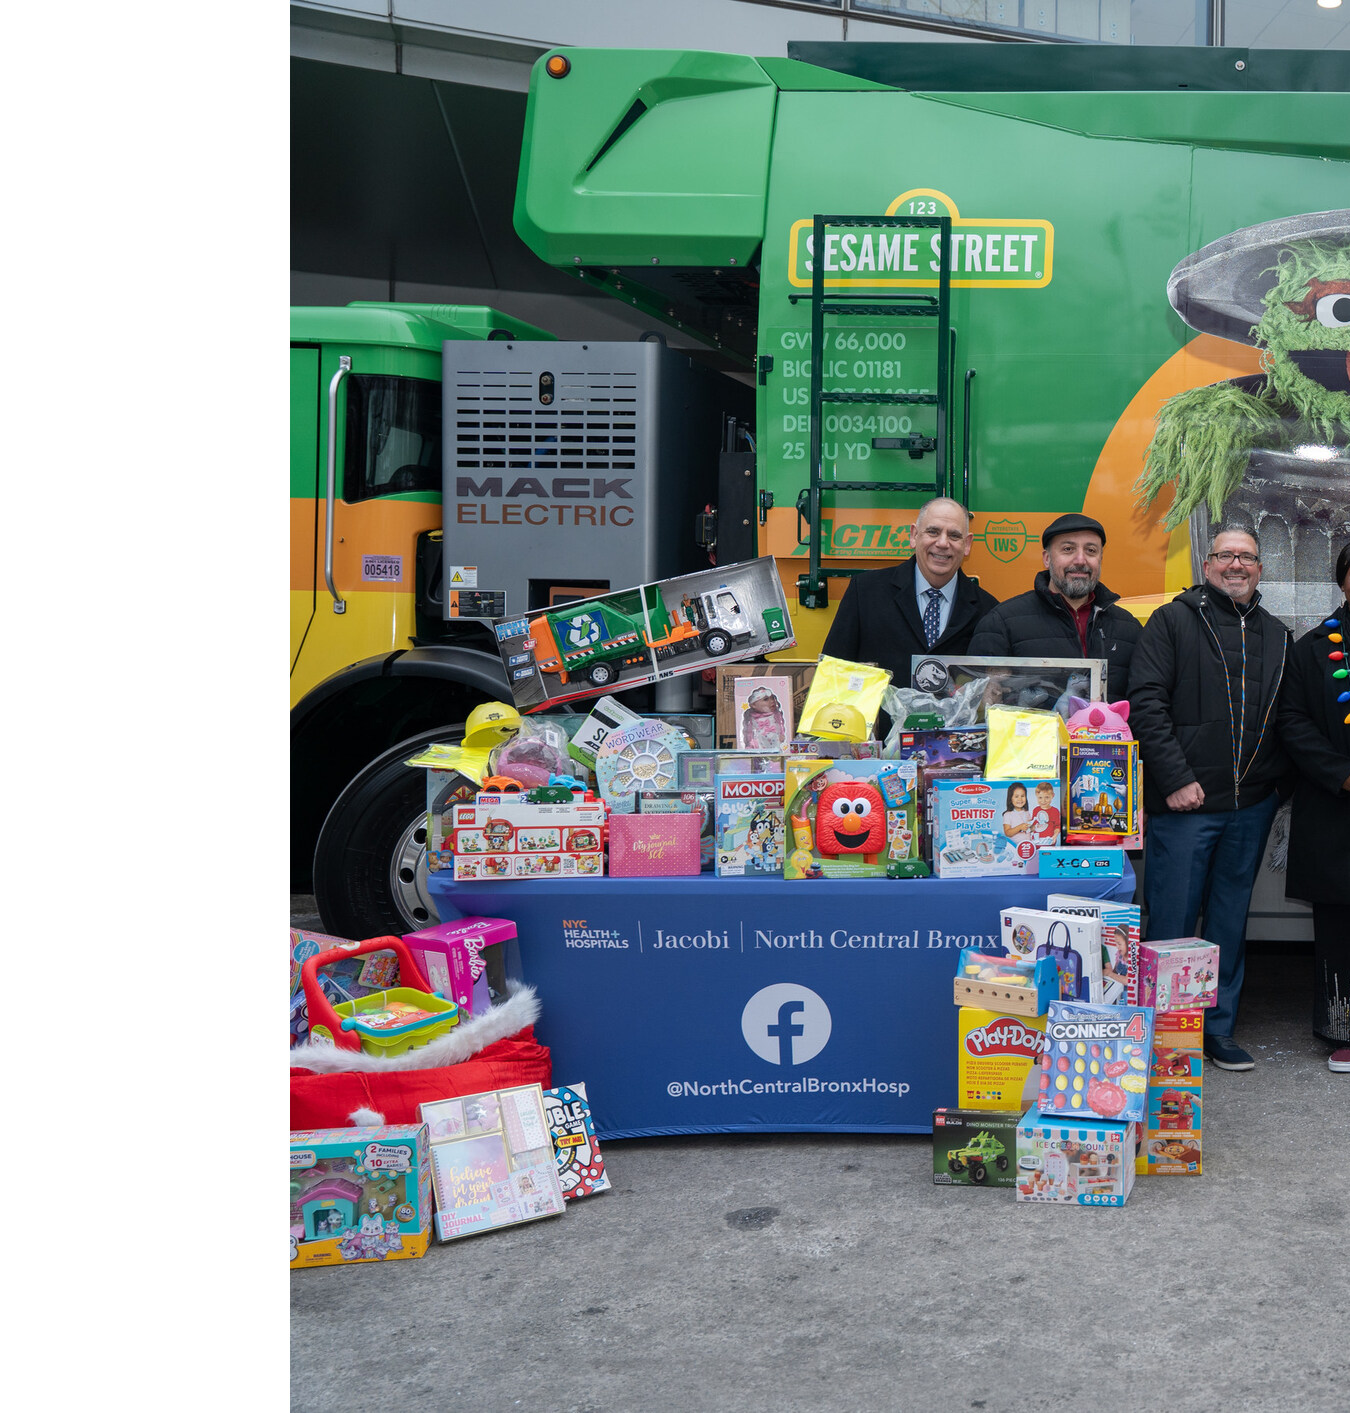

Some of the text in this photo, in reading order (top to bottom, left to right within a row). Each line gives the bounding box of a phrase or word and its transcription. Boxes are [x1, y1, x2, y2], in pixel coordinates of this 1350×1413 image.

[909, 202, 937, 215] 123
[805, 234, 1038, 272] SESAME STREET
[835, 333, 906, 352] 66,000
[853, 361, 901, 378] 01181
[783, 388, 808, 404] US
[826, 415, 912, 433] 0034100
[782, 443, 805, 459] 25
[844, 443, 871, 460] YD
[456, 477, 634, 498] MACK
[457, 504, 634, 526] ELECTRIC
[994, 537, 1018, 553] IWS
[365, 564, 400, 576] 005418
[495, 618, 529, 632] MIGHTY
[499, 625, 531, 641] FLEET
[605, 733, 635, 749] WORD
[636, 723, 665, 739] WEAR
[725, 782, 784, 797] MONOP
[951, 798, 971, 806] Super
[951, 809, 995, 820] DENTIST
[957, 822, 974, 830] Play
[563, 920, 587, 928] NYC
[566, 939, 629, 949] HOSPITALS
[653, 930, 730, 949] Jacobi
[754, 929, 999, 949] North Central Bronx
[463, 935, 487, 981] Barbie
[1052, 1014, 1145, 1041] CONNECT 4
[1180, 1018, 1200, 1029] 3-5
[968, 1026, 1044, 1053] Play-Doh
[667, 1077, 910, 1098] @NorthCentralBronxHosp
[565, 1121, 582, 1129] GAME
[560, 1137, 570, 1146] TRY
[1051, 1142, 1079, 1150] CREAM
[370, 1159, 382, 1167] 10
[449, 1166, 493, 1184] believe
[452, 1184, 467, 1198] in
[441, 1212, 456, 1221] DIY
[443, 1214, 484, 1229] JOURNAL
[444, 1227, 460, 1237] SET
